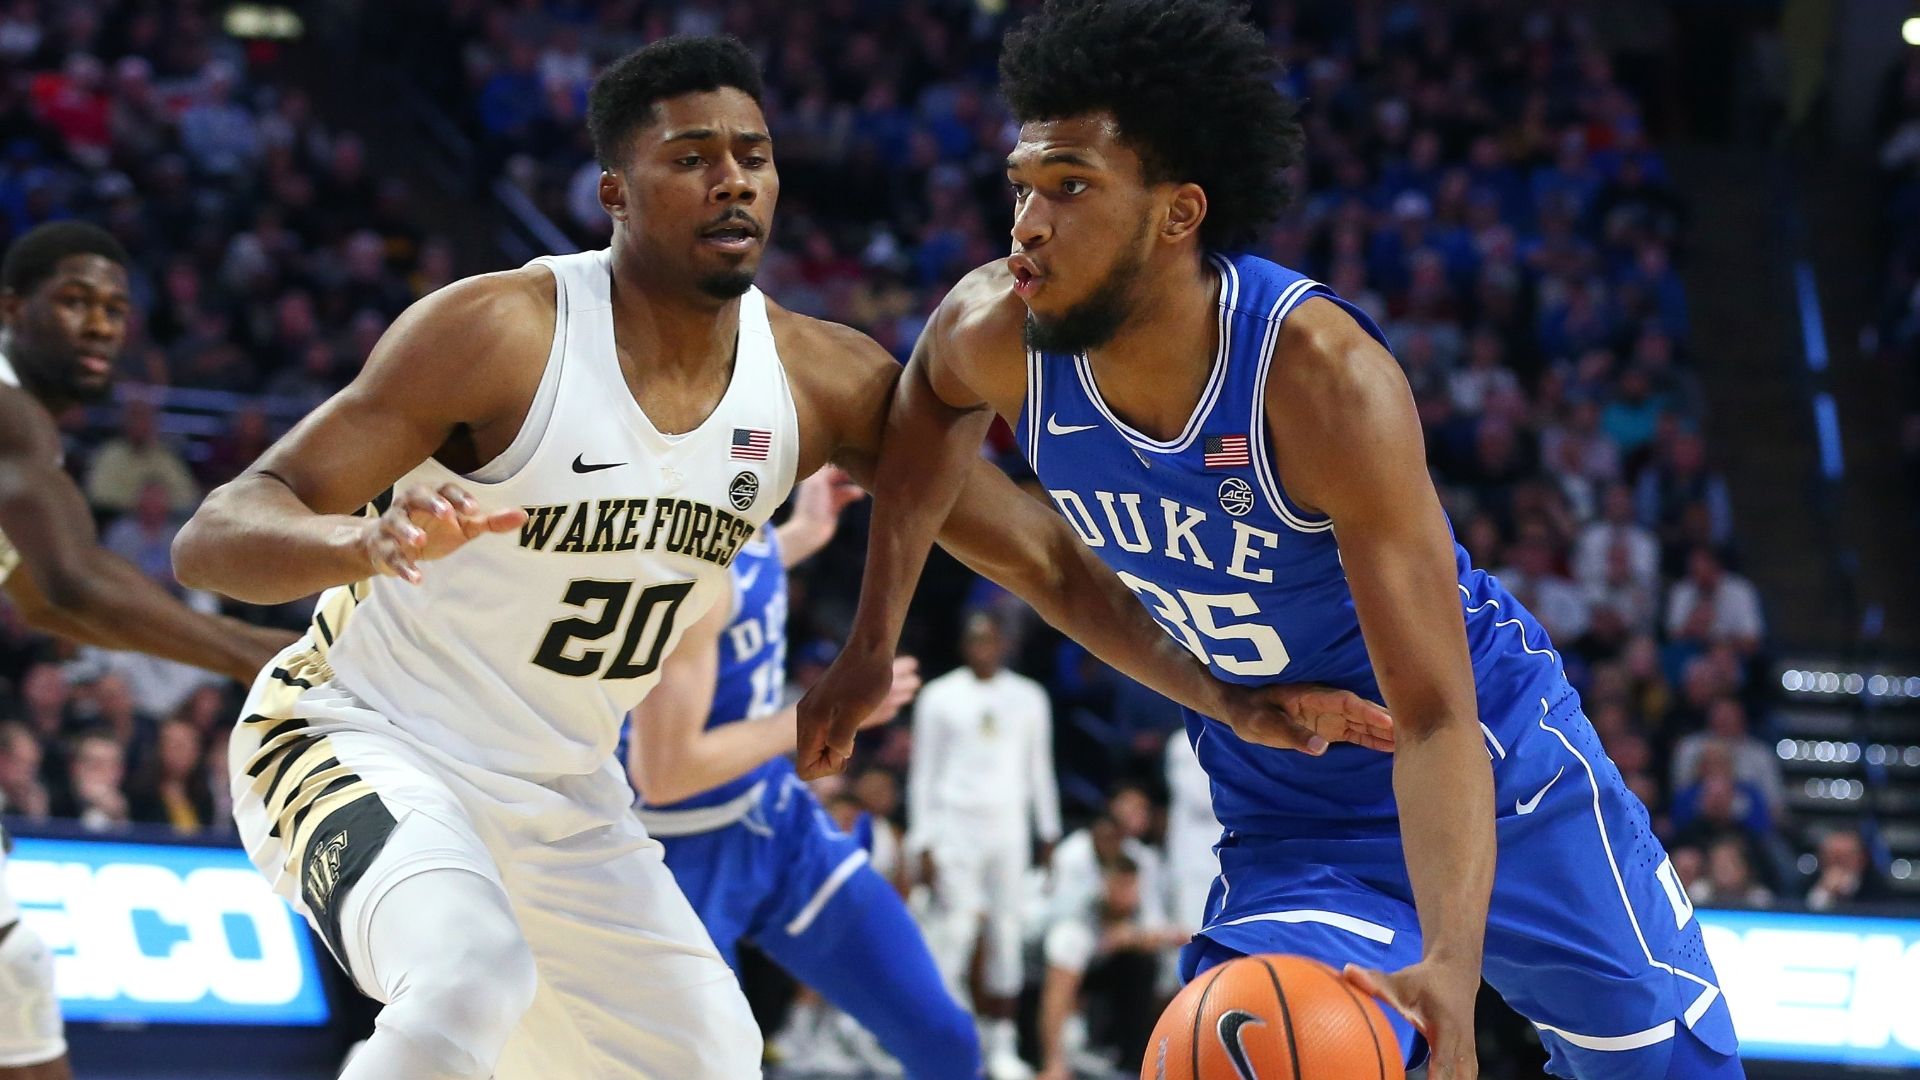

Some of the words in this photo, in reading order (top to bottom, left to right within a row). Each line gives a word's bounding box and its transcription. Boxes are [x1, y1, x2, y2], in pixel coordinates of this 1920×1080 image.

[518, 497, 650, 553] WAKE
[1048, 488, 1279, 584] DUKE
[529, 576, 699, 681] 20
[1116, 570, 1291, 676] 35
